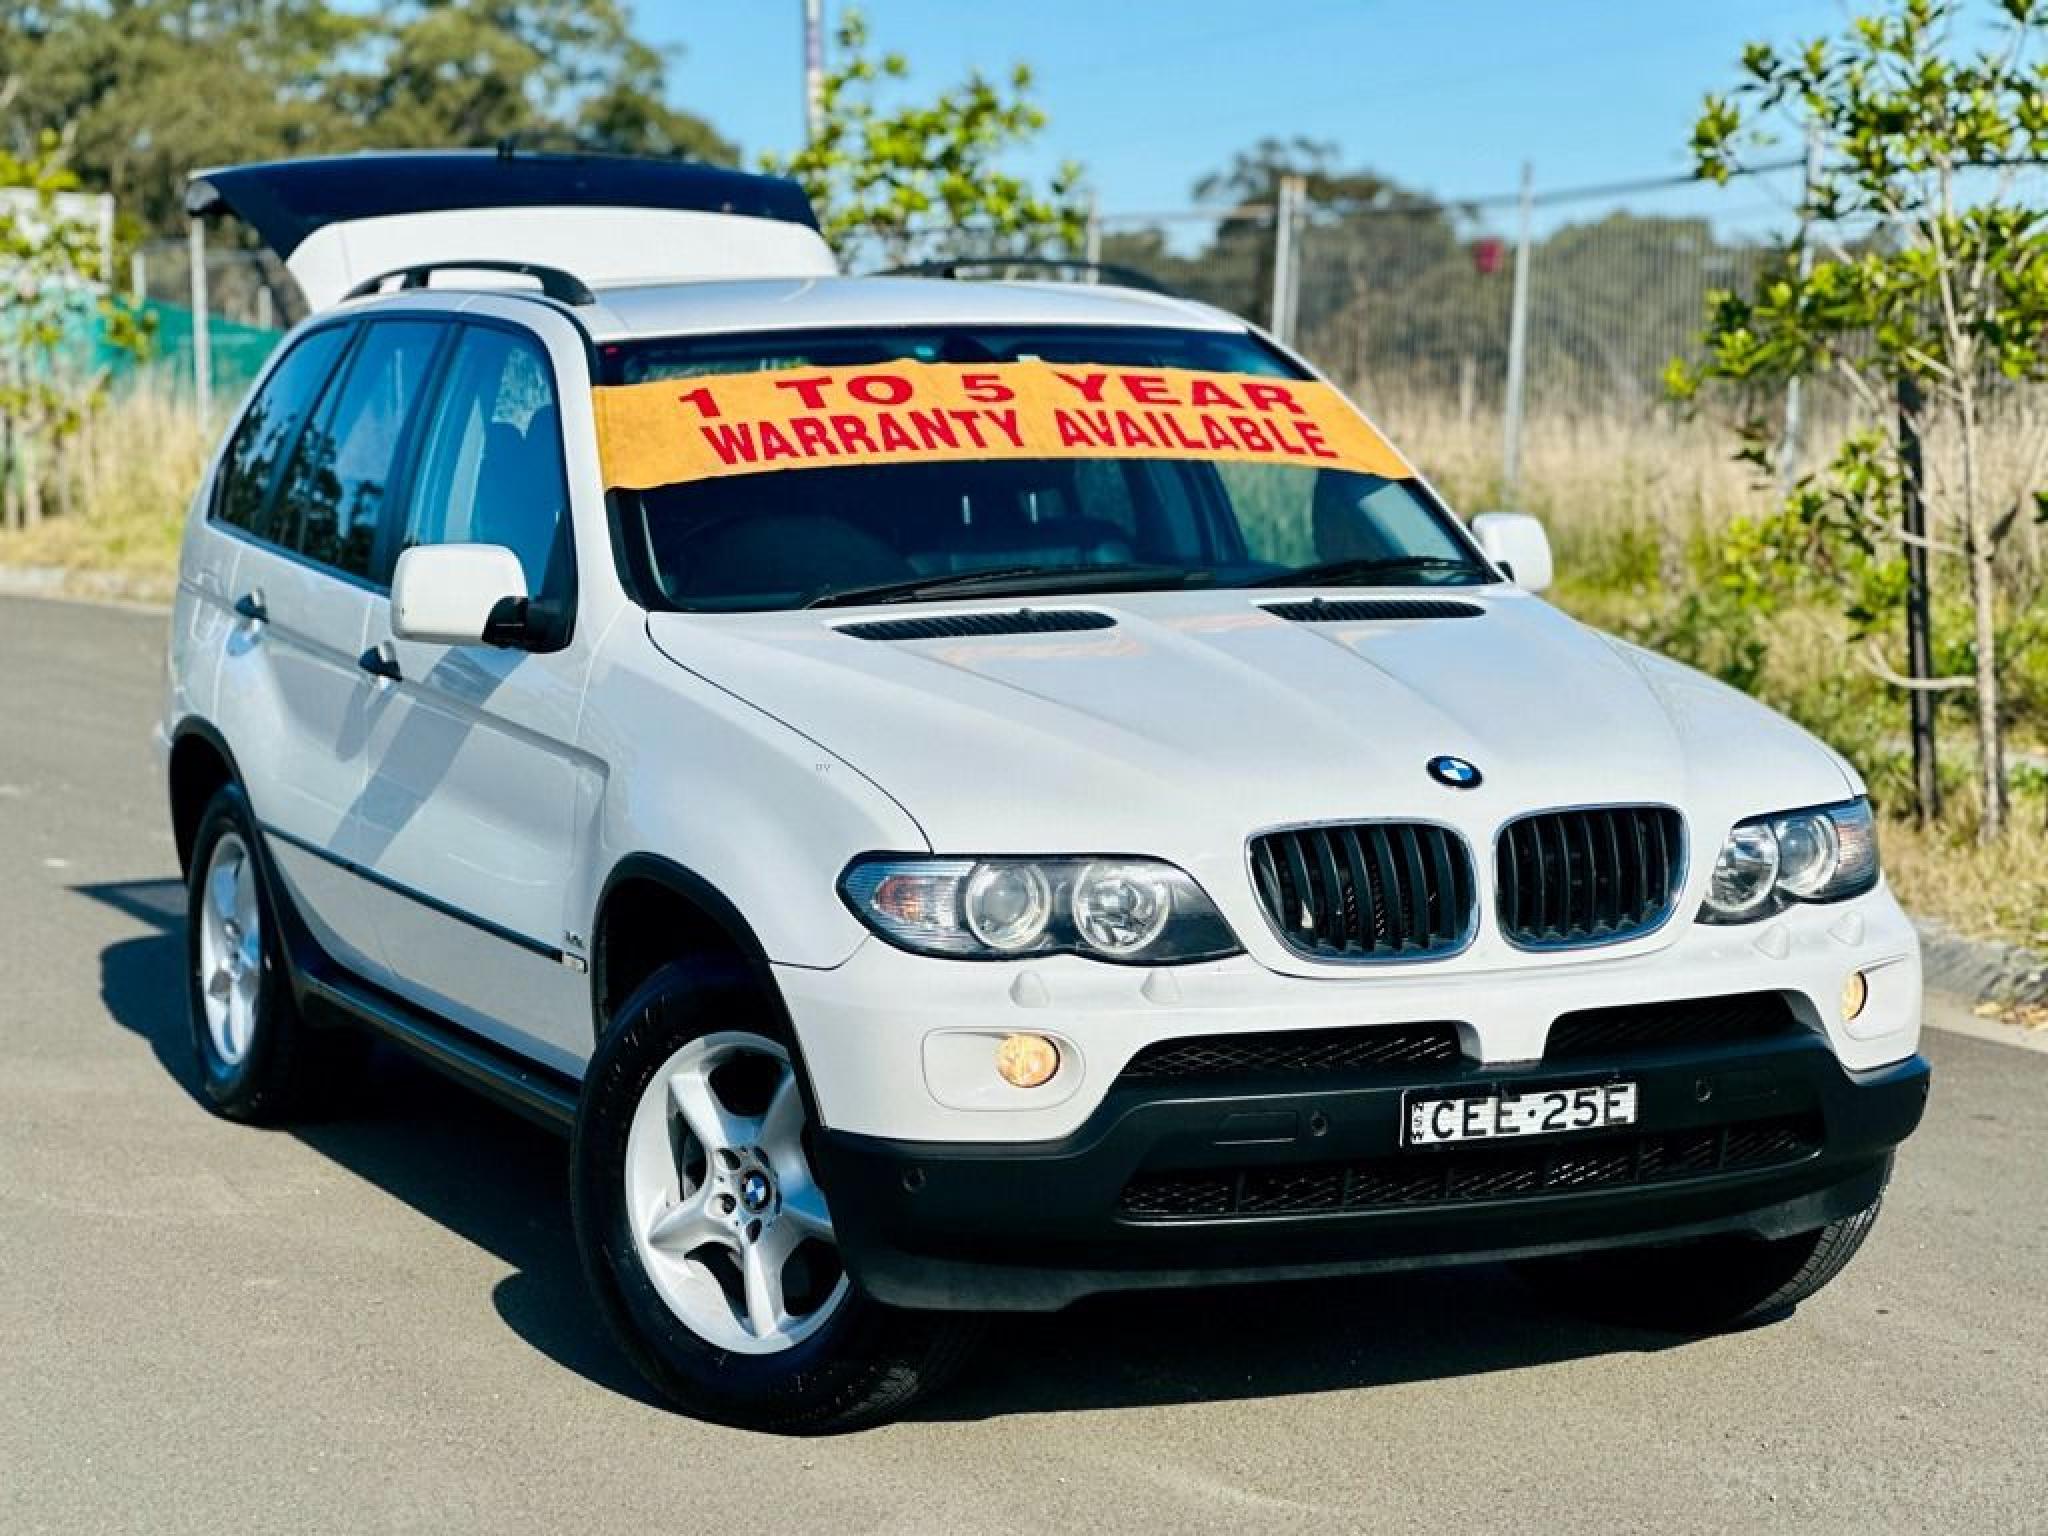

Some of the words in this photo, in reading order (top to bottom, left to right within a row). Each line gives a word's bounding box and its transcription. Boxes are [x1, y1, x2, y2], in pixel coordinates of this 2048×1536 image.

[679, 387, 721, 418] 1
[776, 375, 914, 409] TO
[961, 374, 1017, 402] 5
[1056, 372, 1306, 415] YEAR
[700, 408, 1025, 465] WARRANTY
[1055, 408, 1340, 459] AVAILABLE
